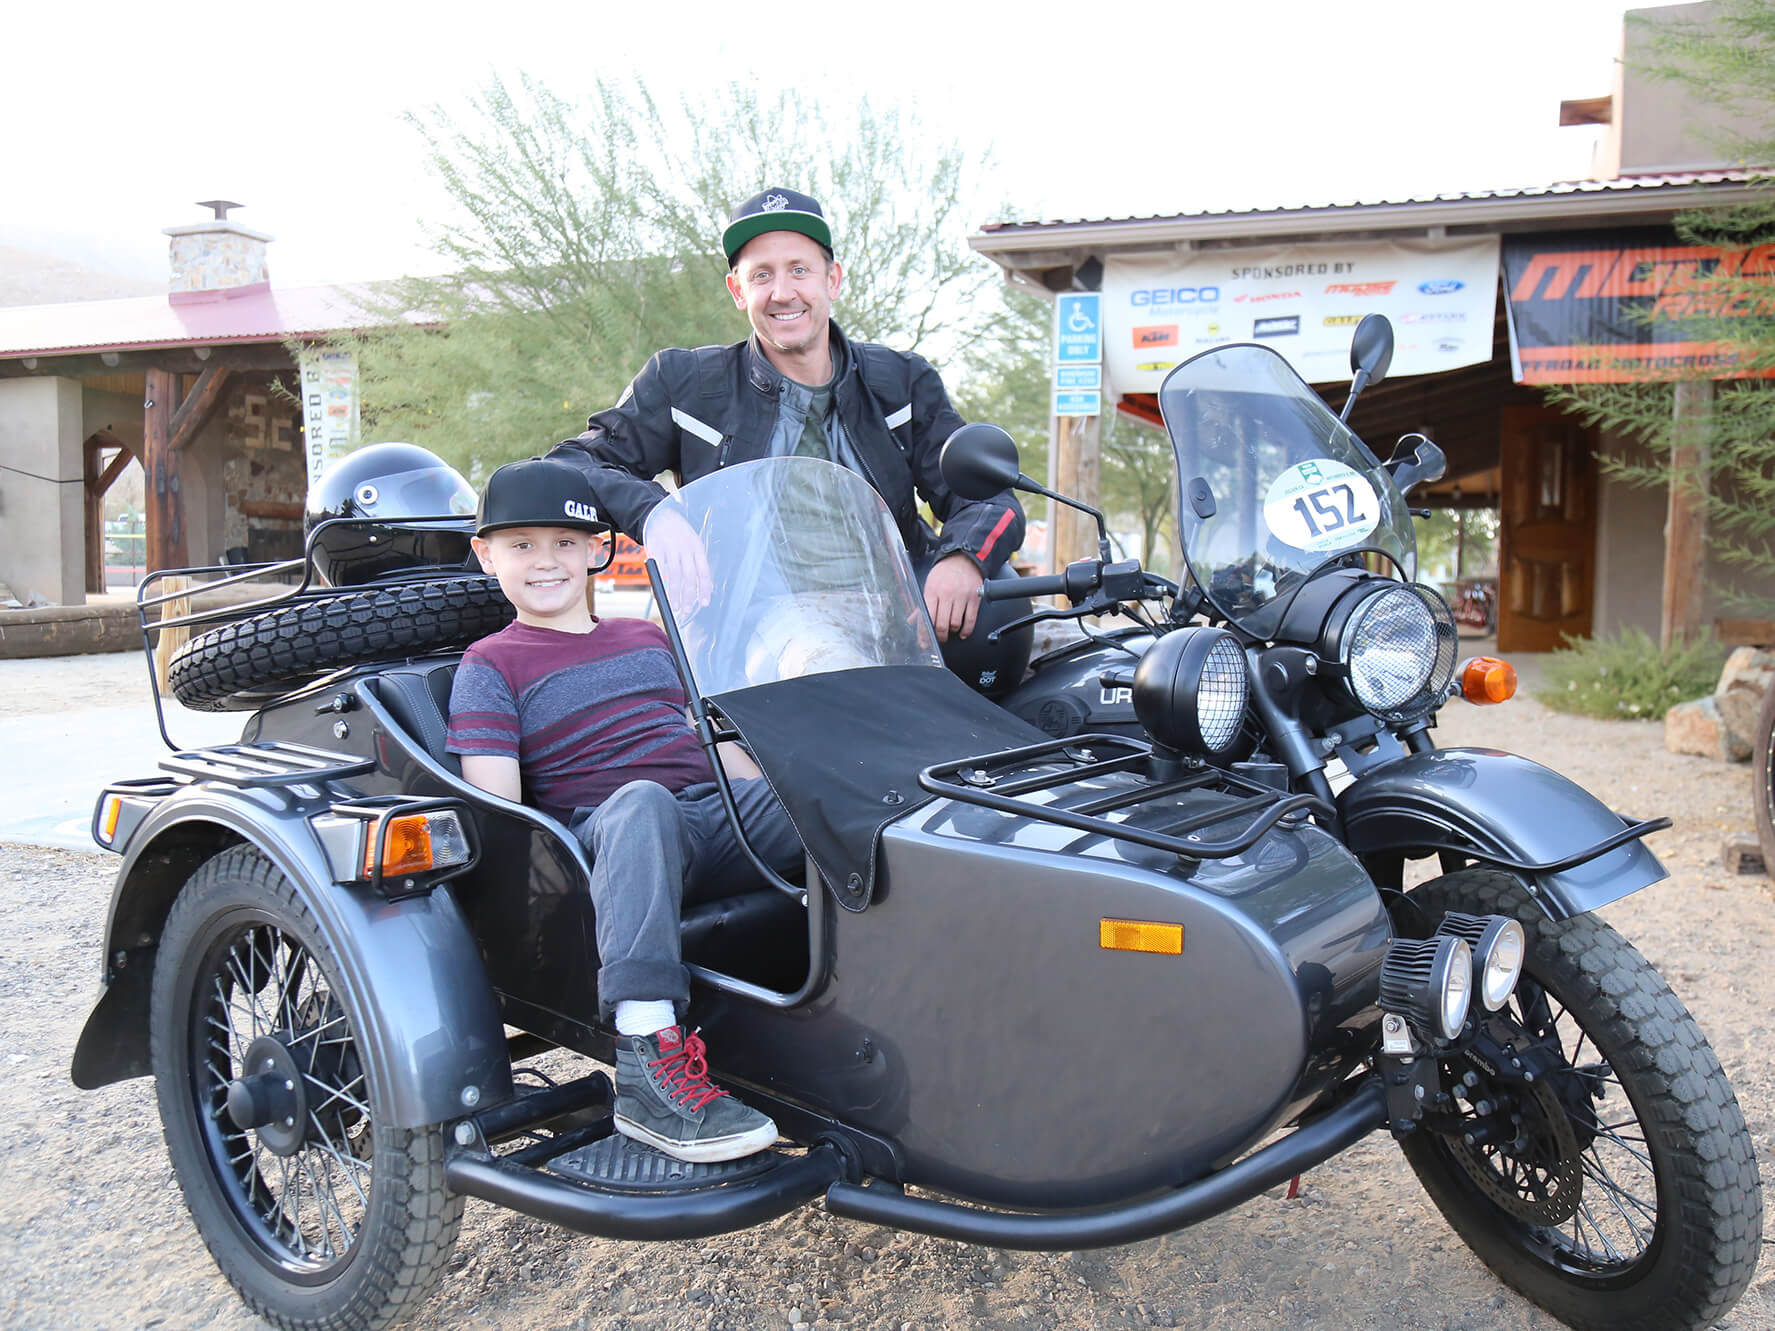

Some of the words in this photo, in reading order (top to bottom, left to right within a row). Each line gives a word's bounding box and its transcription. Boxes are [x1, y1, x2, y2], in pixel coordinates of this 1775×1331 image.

[1231, 263, 1328, 280] SPONSORED
[1334, 262, 1355, 275] BY
[1131, 286, 1220, 306] GEICO
[1293, 483, 1367, 538] 152
[1101, 687, 1133, 705] UR
